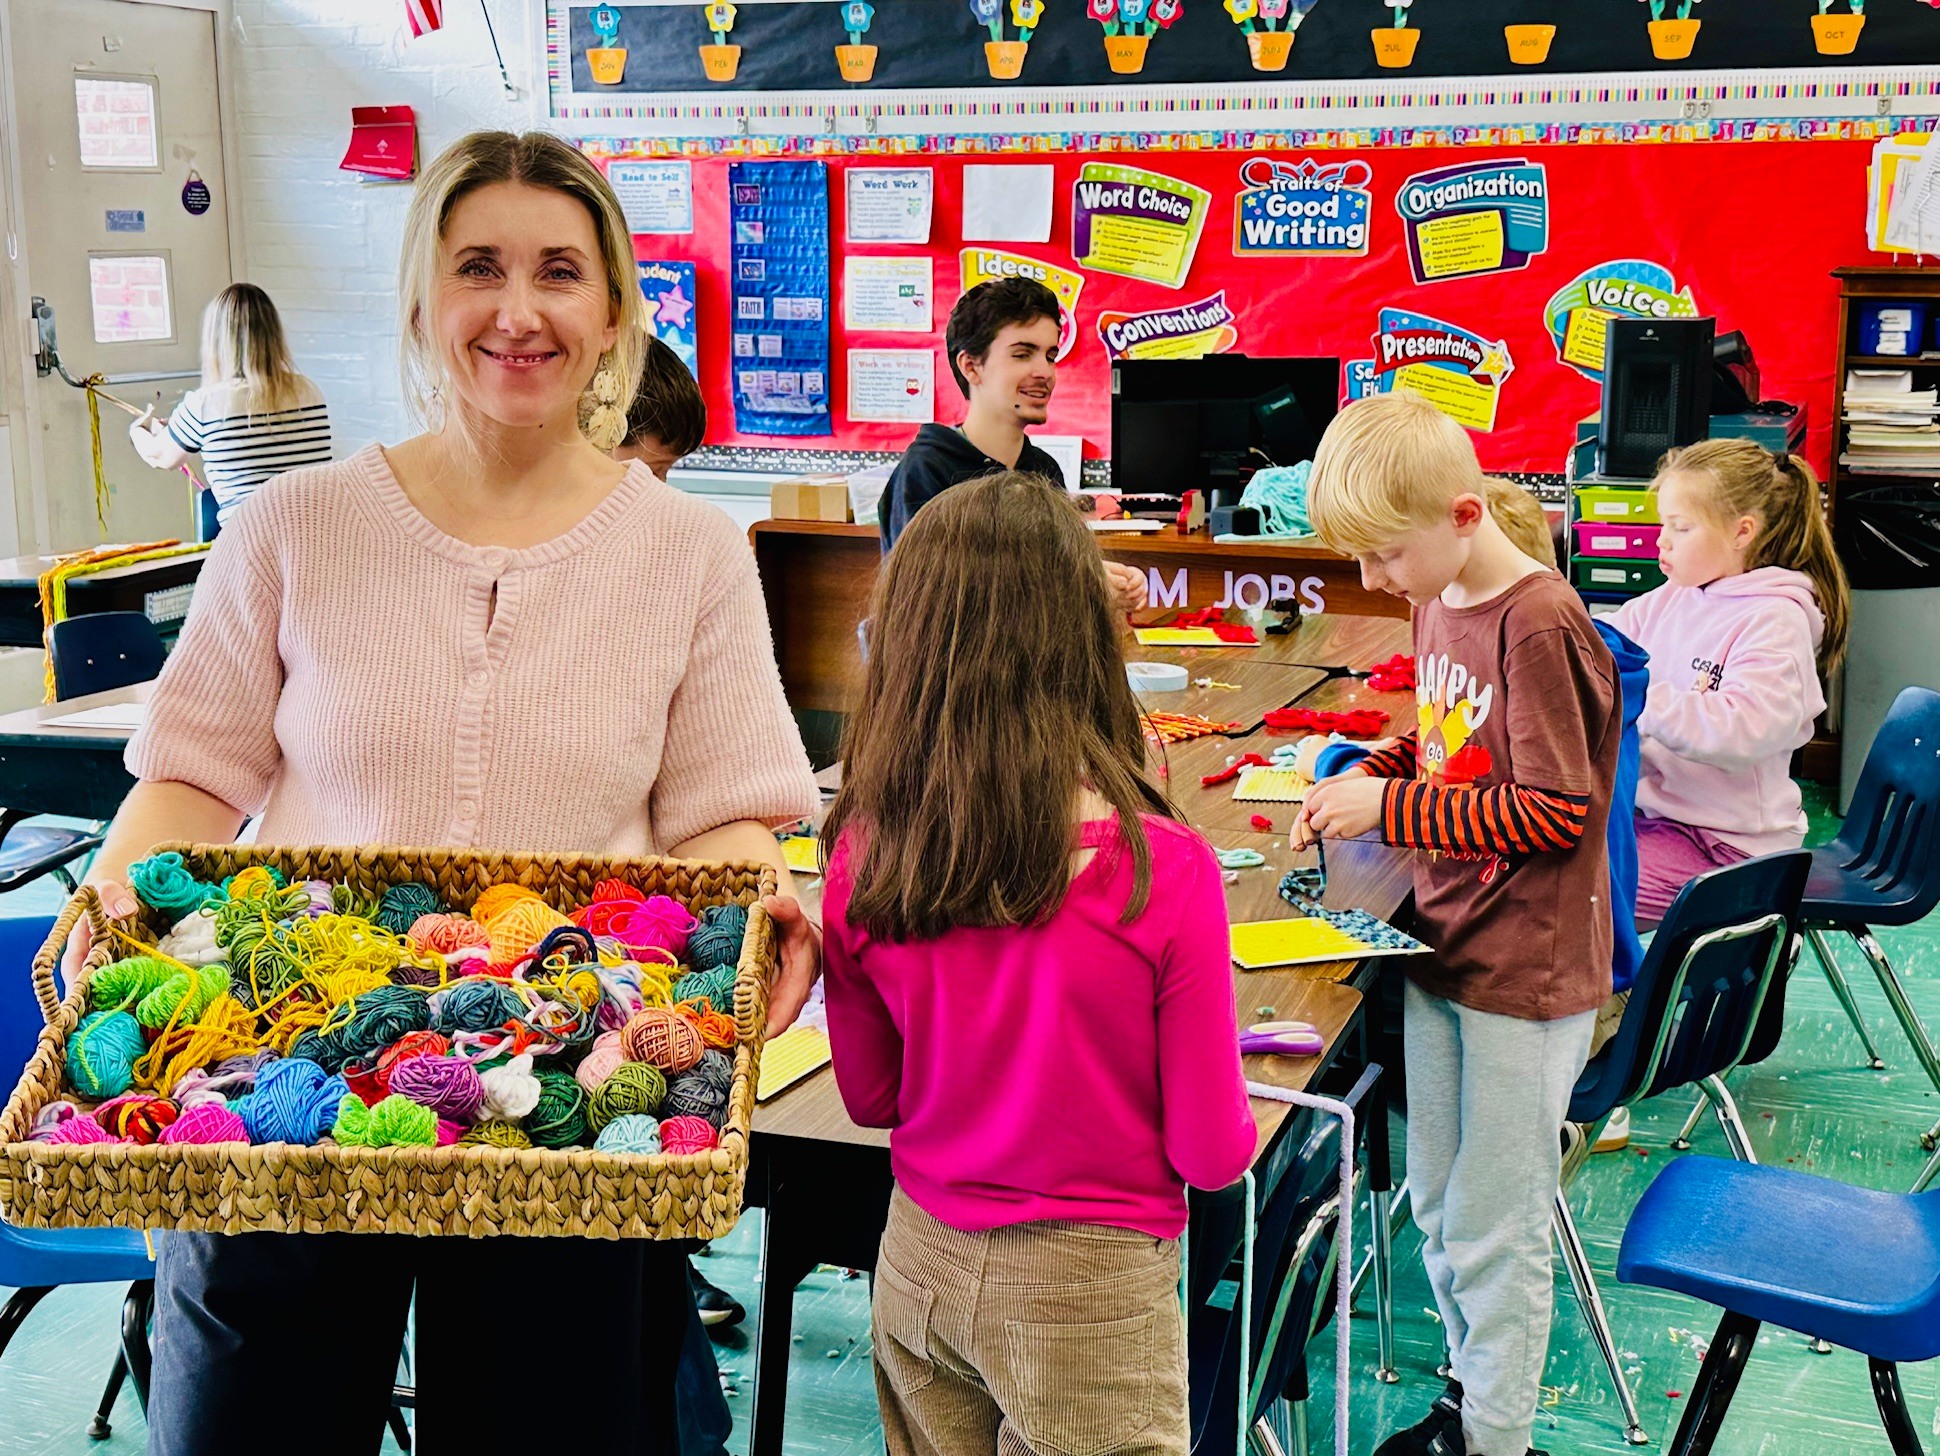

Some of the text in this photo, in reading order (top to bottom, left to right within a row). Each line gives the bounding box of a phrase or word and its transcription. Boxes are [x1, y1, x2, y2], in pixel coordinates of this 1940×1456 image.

[1824, 31, 1845, 39] OCT
[621, 173, 645, 181] Read
[648, 173, 658, 181] to
[862, 180, 919, 189] Word Work
[1269, 177, 1345, 192] Traits of
[1079, 183, 1192, 220] Word Choice
[1266, 195, 1339, 218] Good
[1407, 172, 1543, 214] Organization
[1243, 218, 1365, 249] Writing
[639, 263, 682, 285] udent
[978, 253, 1048, 281] Ideas
[1587, 280, 1671, 318] Voice
[1106, 301, 1227, 352] Conventions
[1380, 332, 1482, 365] Presentation
[1213, 571, 1326, 614] JOBS
